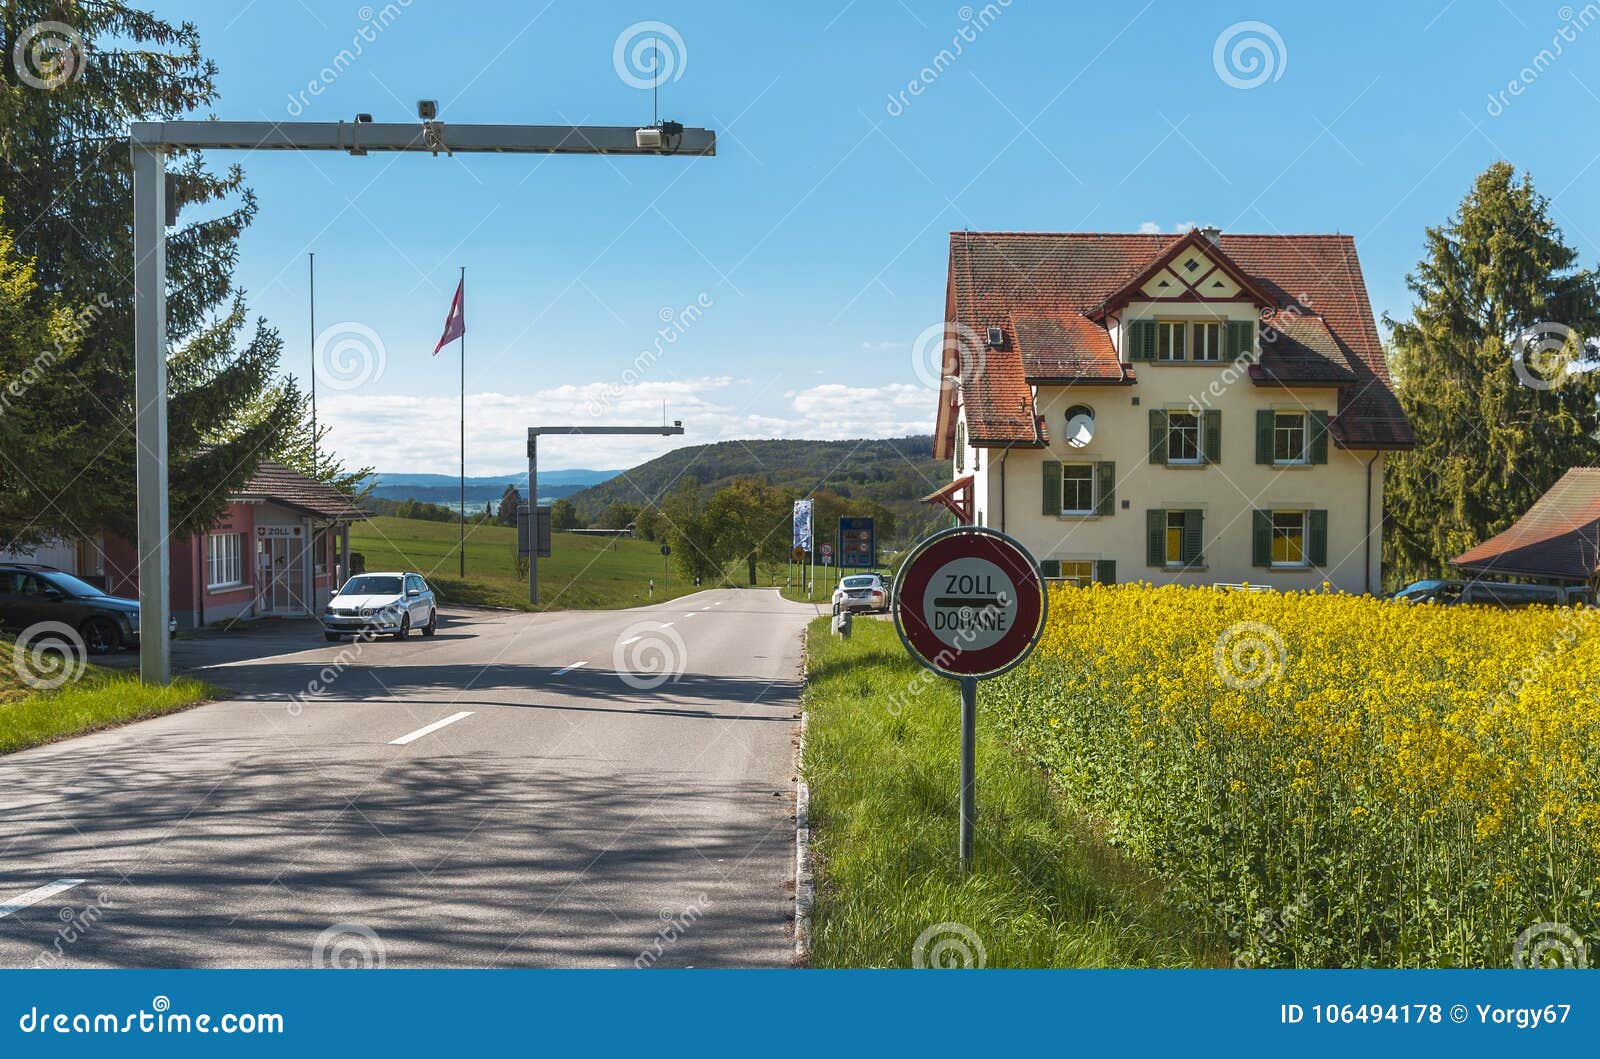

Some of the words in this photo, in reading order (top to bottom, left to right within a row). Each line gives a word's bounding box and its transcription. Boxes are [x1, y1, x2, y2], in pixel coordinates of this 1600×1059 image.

[268, 527, 290, 536] ZOLL
[945, 575, 997, 595] ZOLL
[934, 611, 1006, 631] DOUANE
